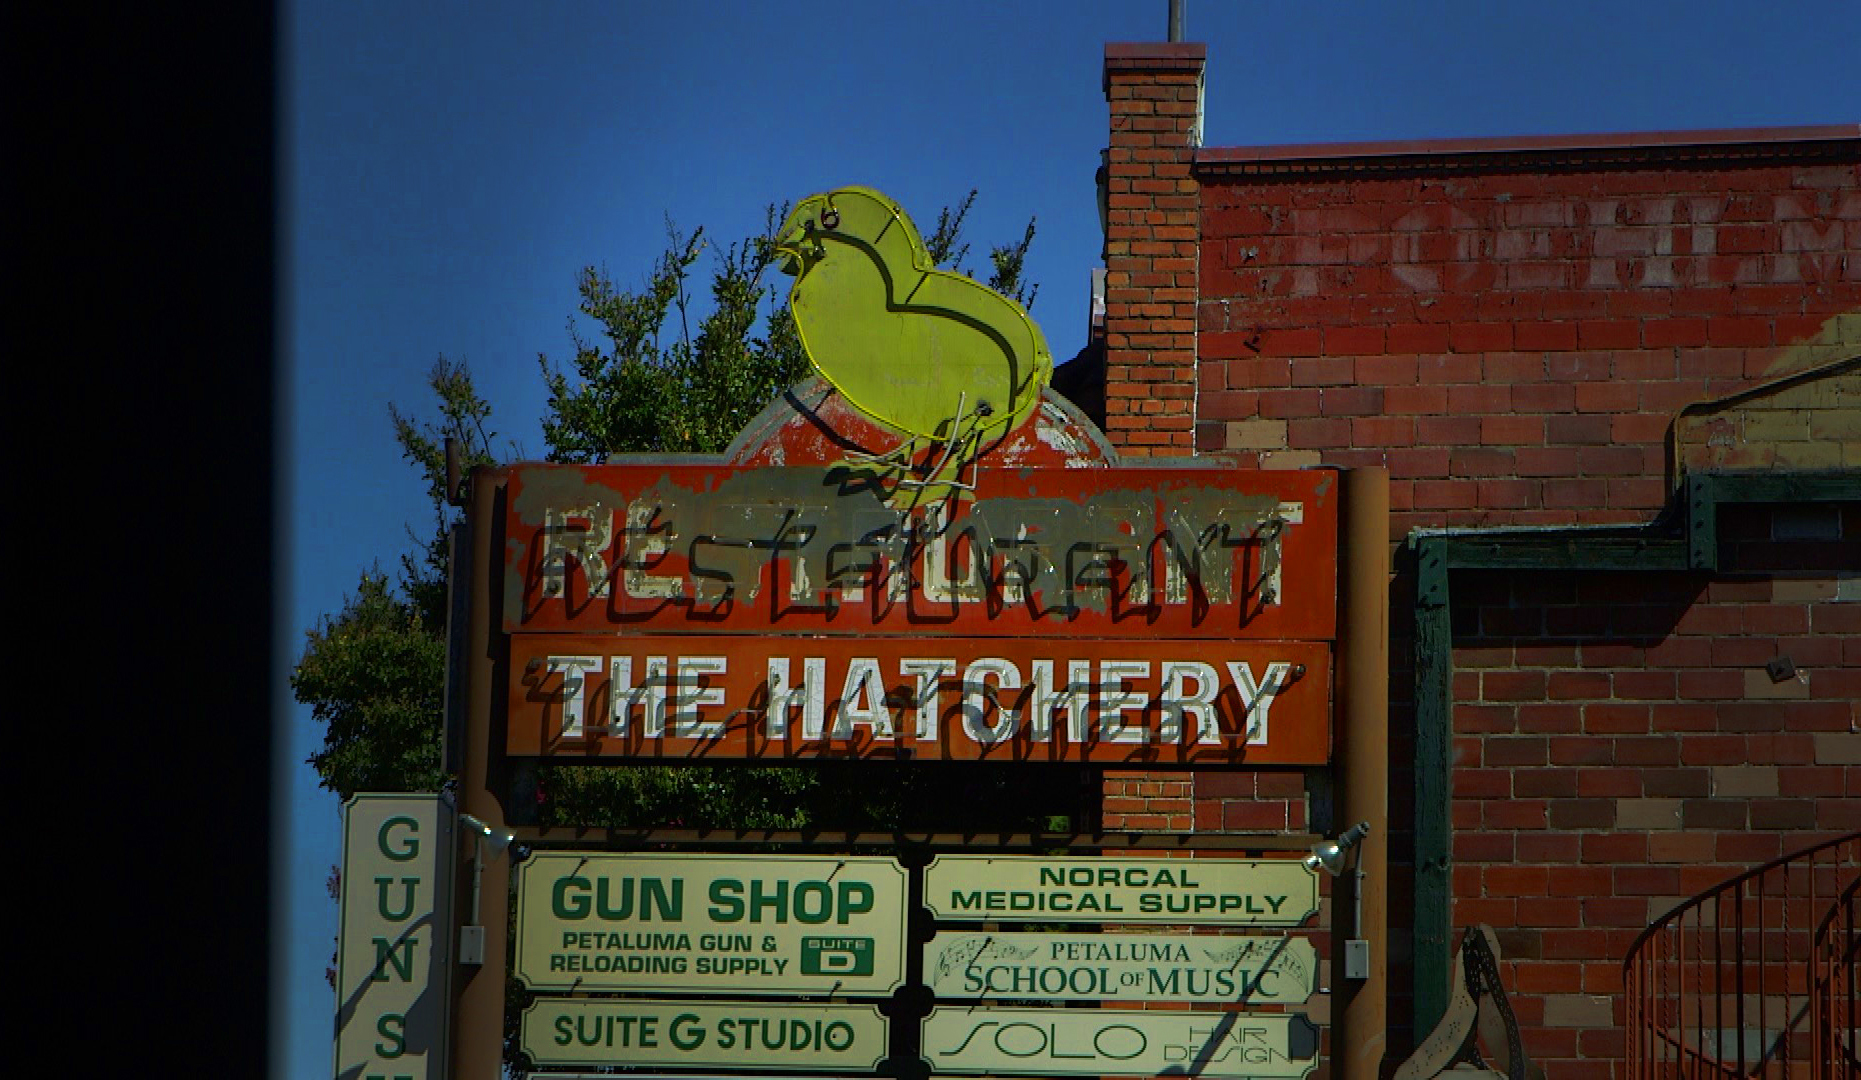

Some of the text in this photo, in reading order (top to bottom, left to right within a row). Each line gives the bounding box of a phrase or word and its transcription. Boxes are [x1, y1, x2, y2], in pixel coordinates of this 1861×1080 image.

[543, 499, 1304, 608] RESTAURANT
[546, 655, 1292, 747] THE HATCHERY
[1039, 867, 1200, 889] NORCAL
[371, 815, 420, 982] GUN
[551, 877, 875, 925] GUN SHOP
[951, 891, 1288, 915] MEDICAL SUPPLY
[562, 932, 777, 952] PETALUMA GUN &
[808, 939, 866, 951] SUITE
[1050, 941, 1192, 962] PETALUMA
[550, 953, 789, 976] RELOADING SUPPLY
[819, 950, 857, 973] D
[964, 964, 1281, 998] SCHOOL OF MUSIC
[554, 1013, 856, 1051] SUITE G STUDIO
[939, 1020, 1148, 1060] SOLO
[1188, 1024, 1268, 1045] HAIR
[366, 1012, 415, 1080] S
[1163, 1044, 1294, 1066] DESIGN
